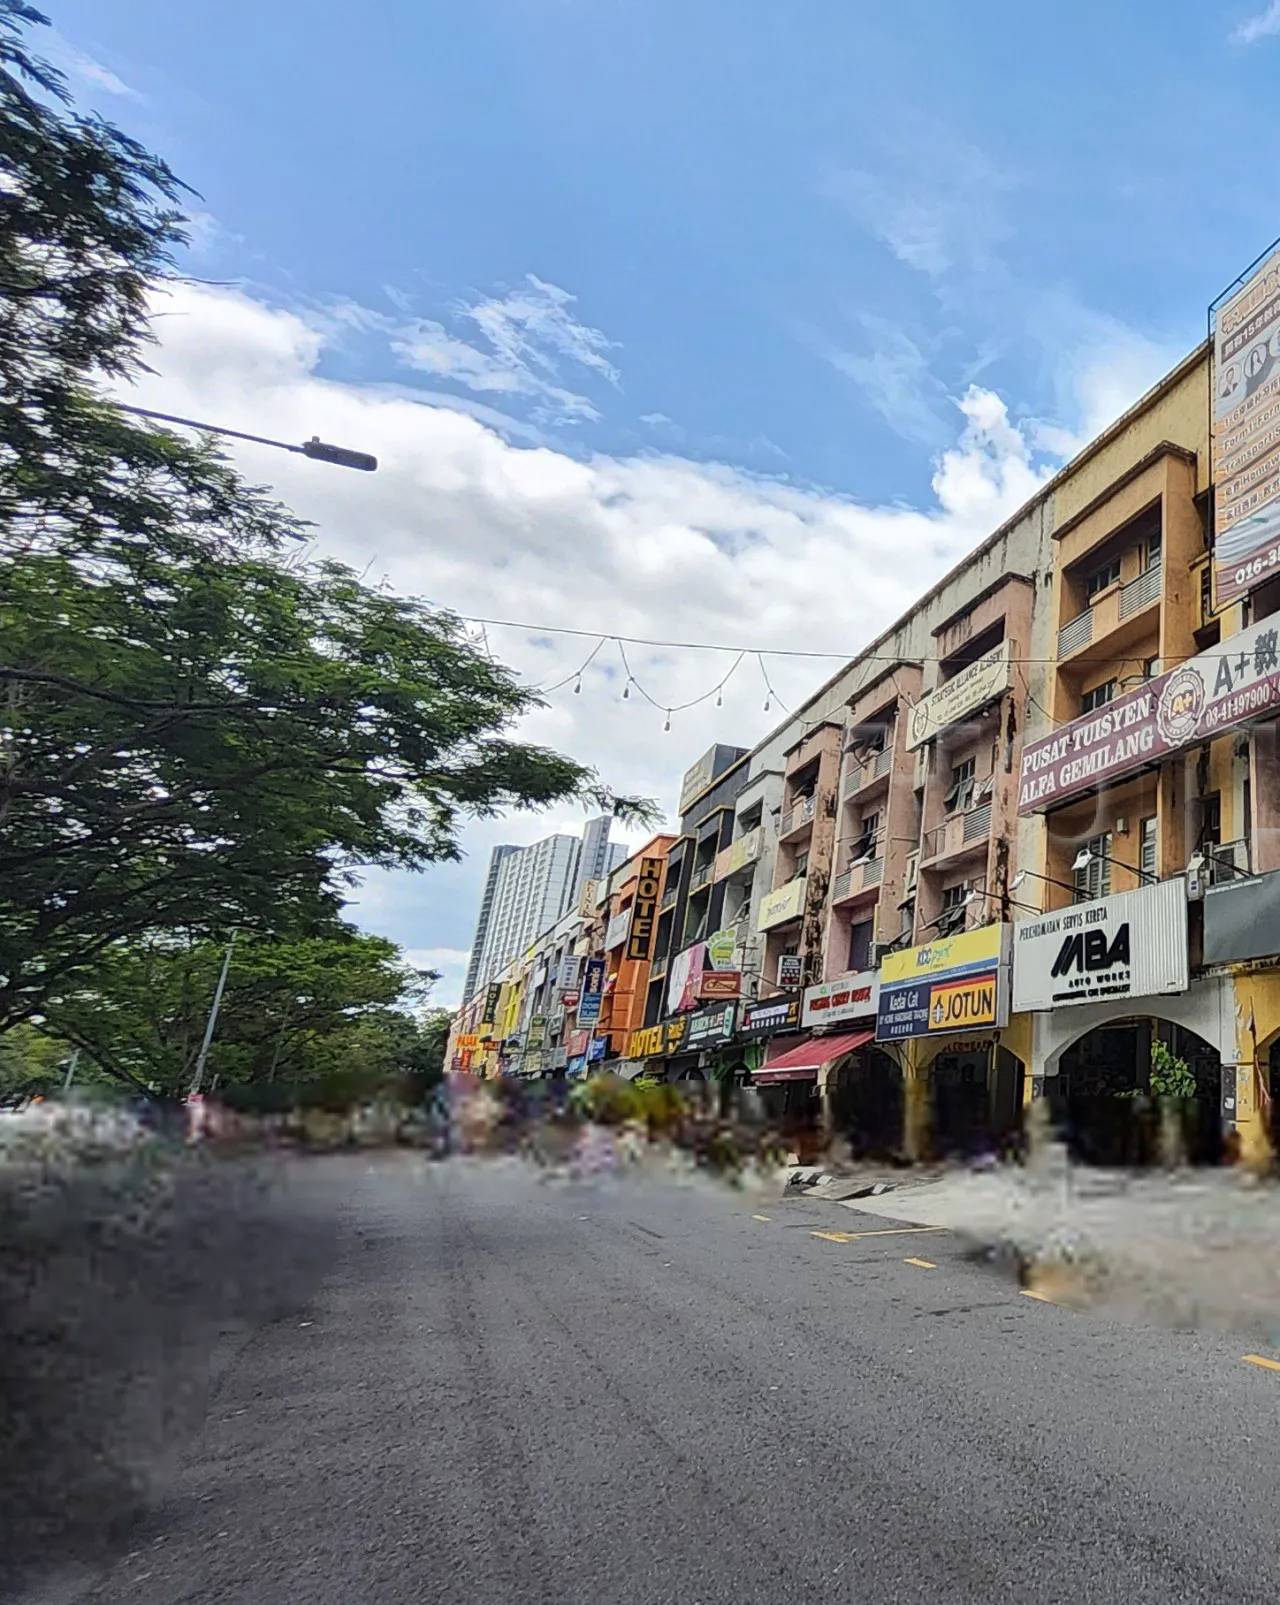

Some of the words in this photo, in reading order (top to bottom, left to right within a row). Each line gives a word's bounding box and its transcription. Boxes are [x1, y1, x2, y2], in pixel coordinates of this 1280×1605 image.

[1225, 432, 1273, 472] Transport
[1022, 734, 1070, 777] PUSAT
[1072, 693, 1152, 751] TUISYEN
[1019, 770, 1056, 807] ALFA
[1060, 724, 1154, 788] GEMILANG
[630, 859, 661, 957] HOTEL
[1063, 912, 1083, 931] SERVIS
[1085, 906, 1108, 925] KERETA
[889, 991, 906, 1011] Kedai
[907, 990, 919, 1008] Cat
[945, 986, 993, 1022] JOTUN
[629, 1024, 664, 1059] HOTEL
